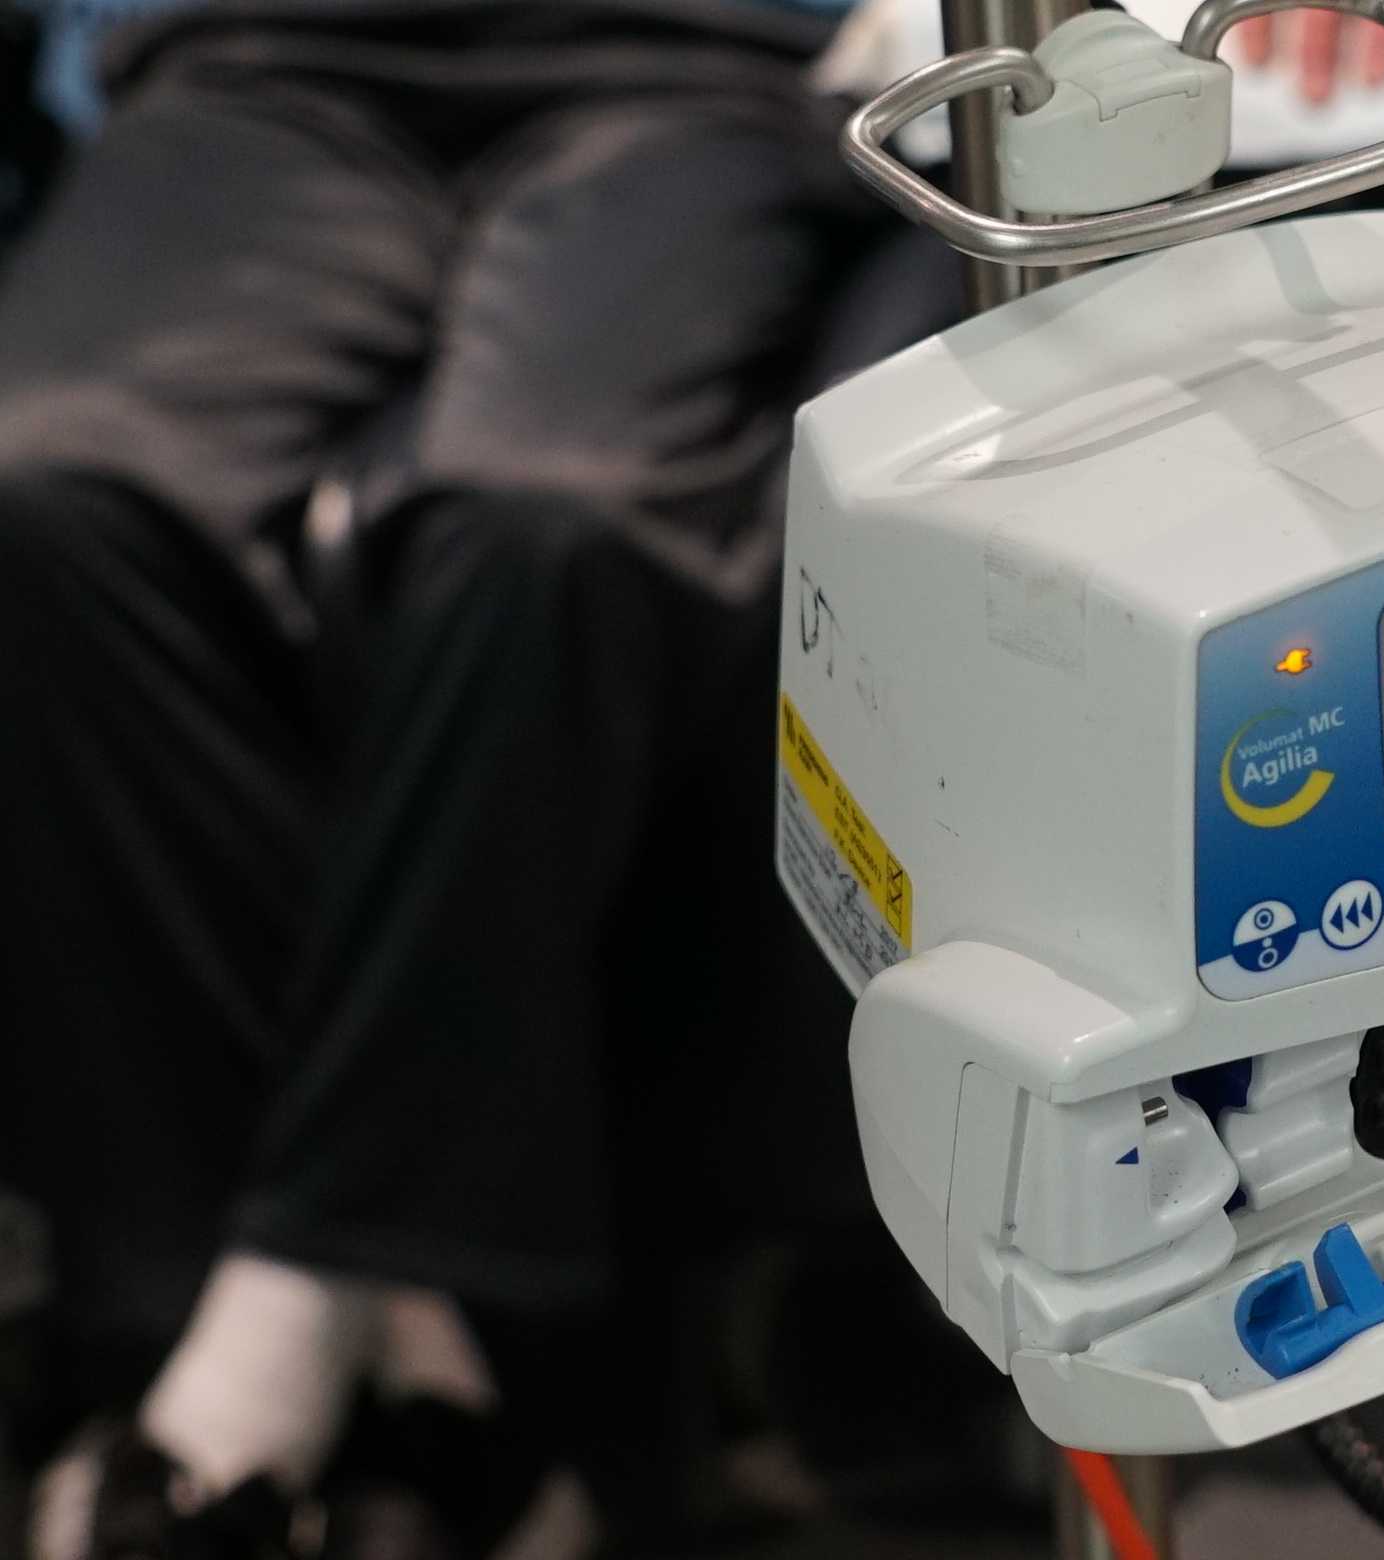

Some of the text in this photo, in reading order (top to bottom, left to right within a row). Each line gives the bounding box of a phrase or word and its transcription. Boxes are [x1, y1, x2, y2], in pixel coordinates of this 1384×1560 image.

[1236, 706, 1346, 761] Volumat MC
[1241, 744, 1319, 788] Agilia
